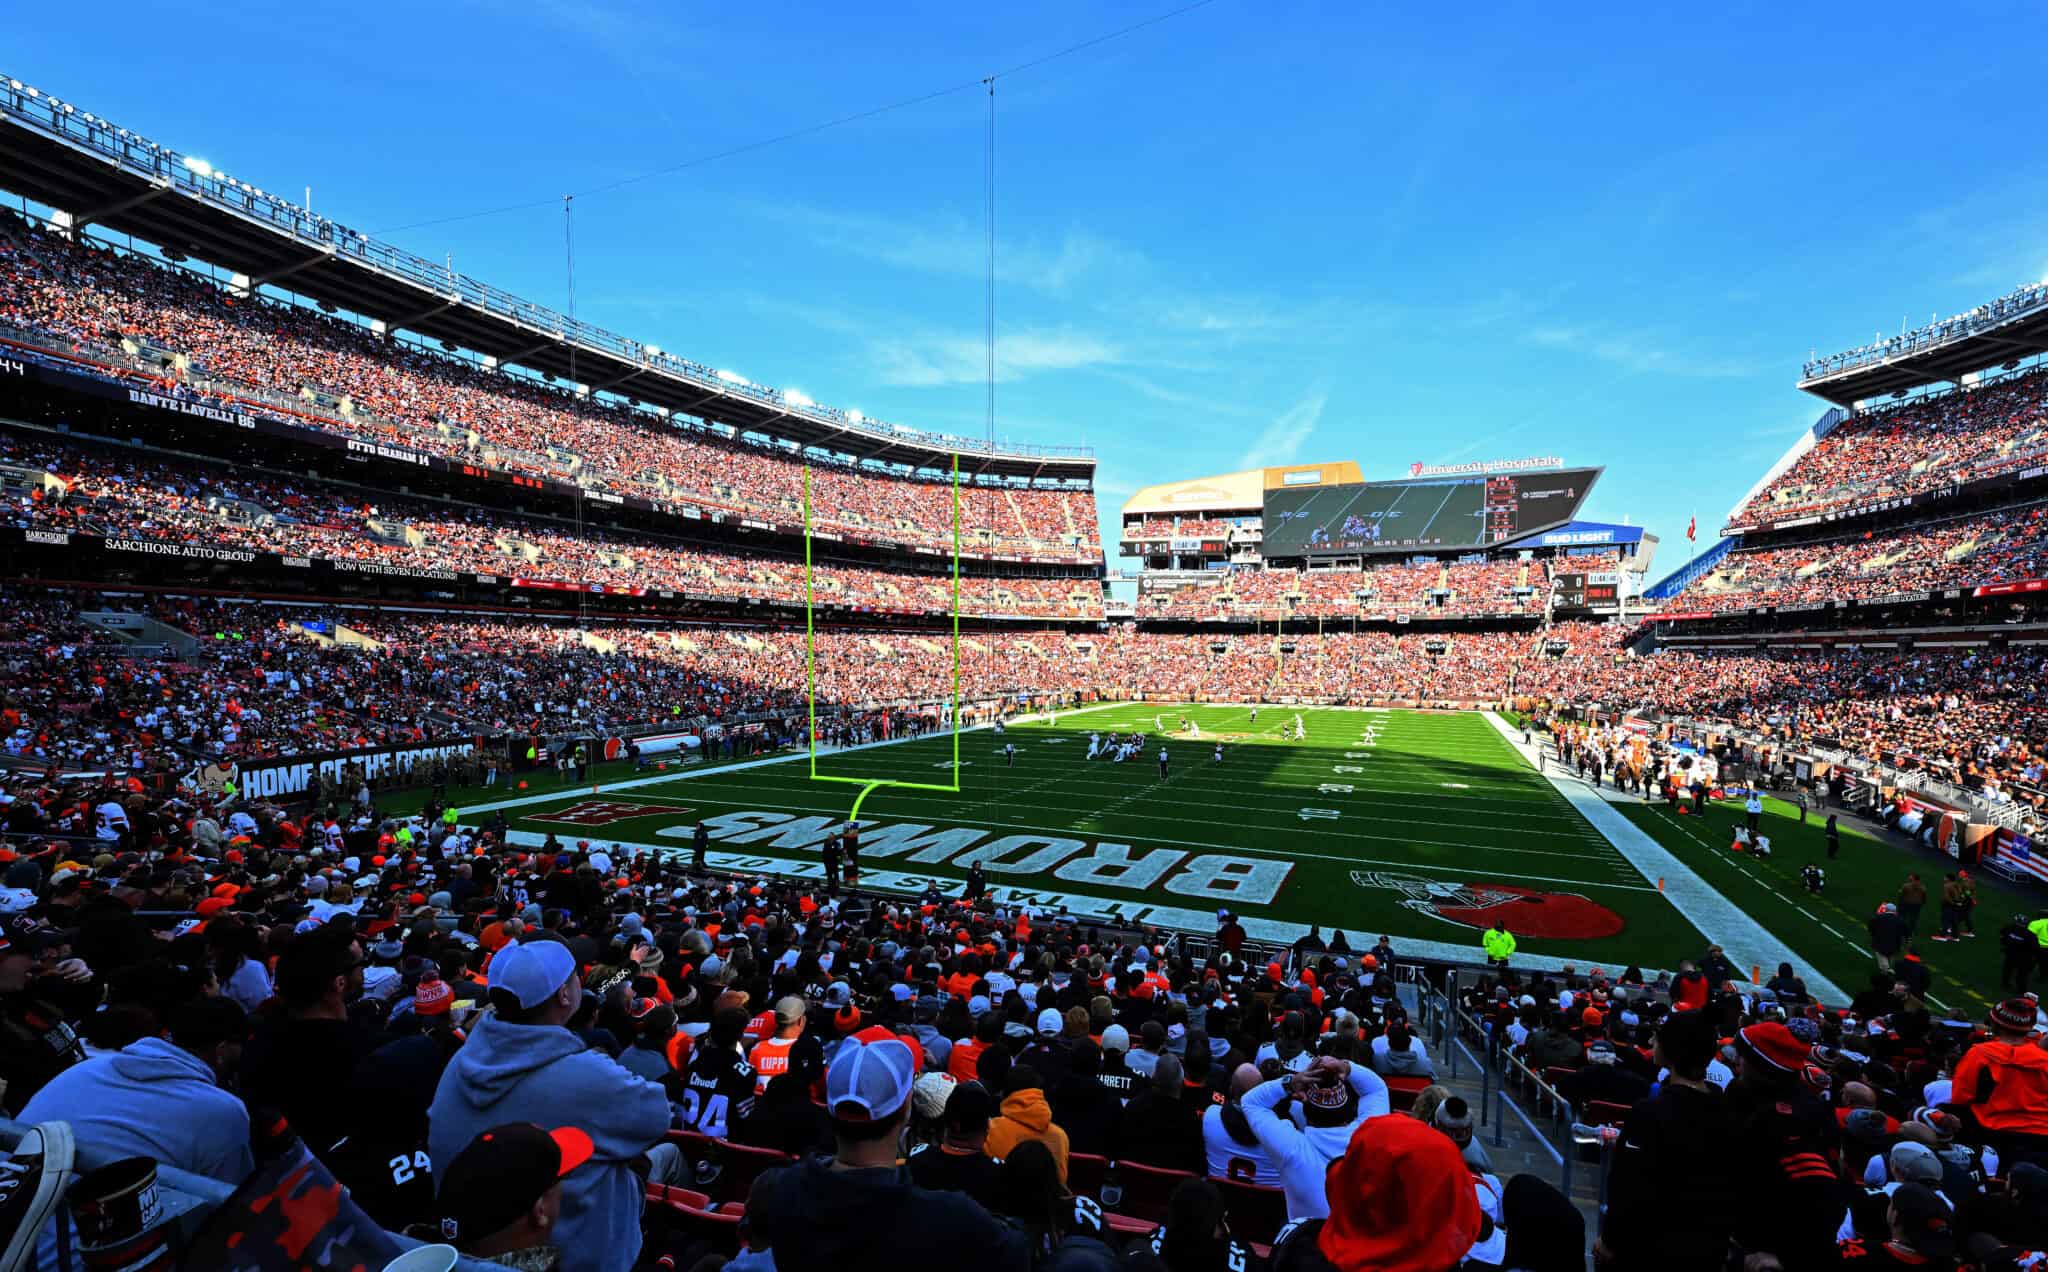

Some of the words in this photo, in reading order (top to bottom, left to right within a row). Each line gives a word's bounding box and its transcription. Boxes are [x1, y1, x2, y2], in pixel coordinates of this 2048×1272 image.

[129, 389, 180, 410] DANTE
[181, 402, 235, 424] LAVELLI
[347, 439, 375, 454] OTTO
[377, 445, 417, 463] GRAHAM
[1423, 462, 1490, 475] University
[1492, 457, 1562, 472] Hospitals
[1544, 533, 1571, 543] BUD
[1573, 532, 1611, 543] LIGHT
[105, 538, 181, 557] SARCHIONE
[182, 544, 215, 559] AUTO
[216, 548, 256, 562] GROUP
[334, 560, 358, 573] NOW
[358, 563, 383, 575] WITH
[383, 565, 411, 578] SEVEN
[242, 763, 315, 801] HOME
[319, 758, 350, 785] OF
[656, 811, 1295, 906] BROWNS
[388, 1149, 433, 1185] 24
